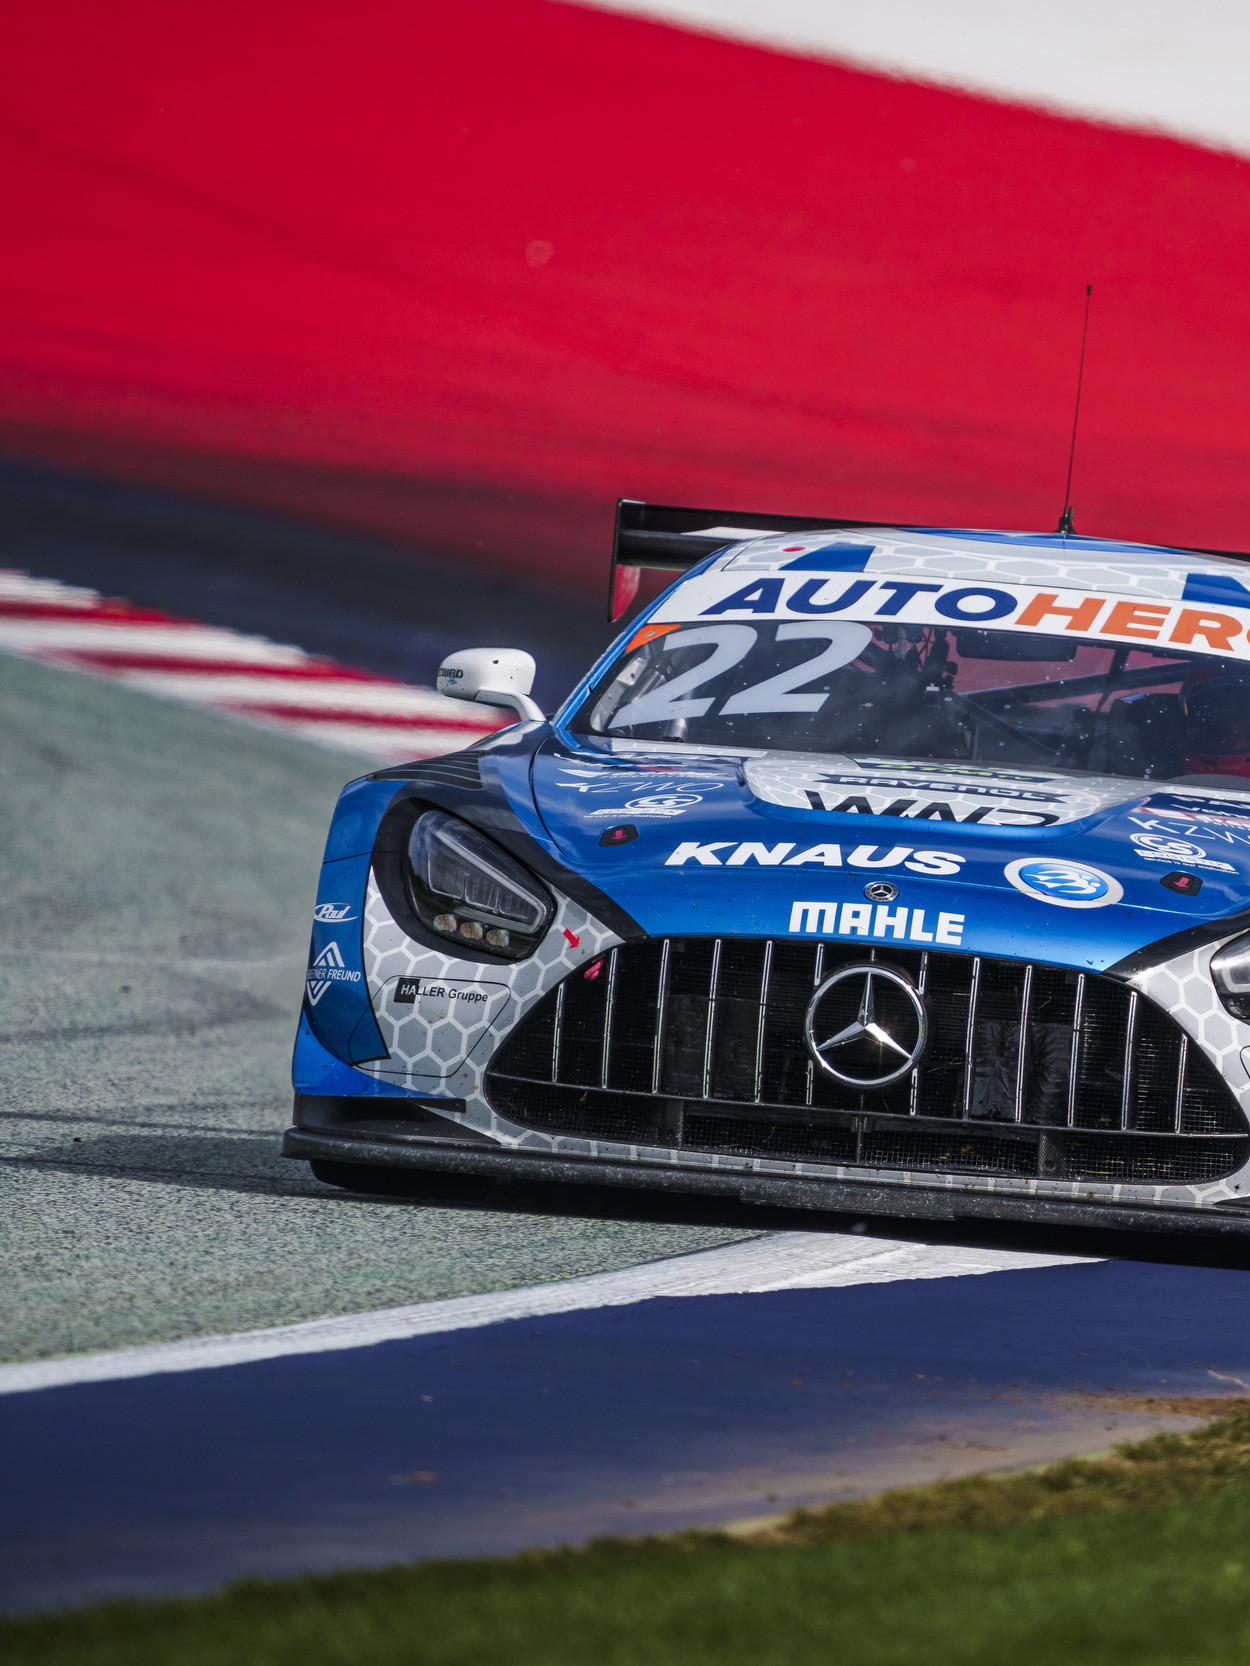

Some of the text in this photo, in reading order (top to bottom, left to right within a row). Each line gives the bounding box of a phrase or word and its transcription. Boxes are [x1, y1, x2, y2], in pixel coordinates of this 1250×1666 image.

[607, 621, 873, 730] 22
[839, 776, 1048, 800] RAVENOL
[665, 841, 967, 876] KNAUS
[788, 900, 966, 946] MAHLE
[327, 969, 362, 982] FREUND
[401, 984, 489, 1003] HALLER Gruppe
